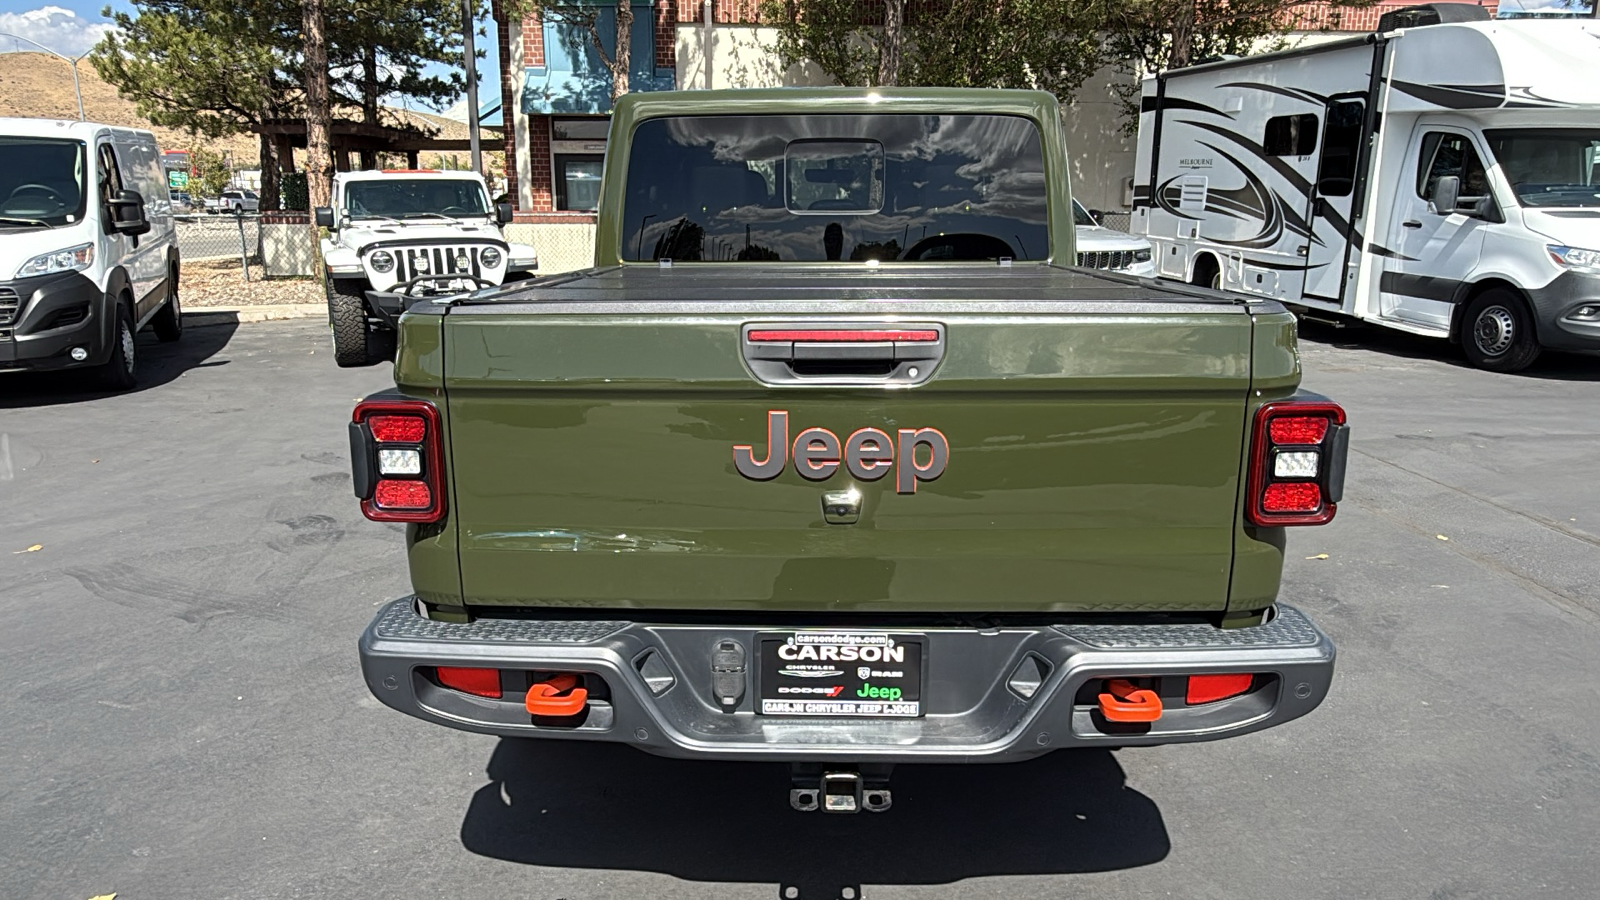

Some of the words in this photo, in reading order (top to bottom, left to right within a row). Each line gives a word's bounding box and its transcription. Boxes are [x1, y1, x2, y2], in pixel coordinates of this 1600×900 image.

[1179, 158, 1213, 166] MELBOURNE
[733, 410, 950, 494] Jeep
[797, 634, 886, 645] carsondodge.com
[778, 643, 904, 663] CARSON
[871, 670, 903, 678] RAM
[778, 686, 835, 694] DODGE
[856, 683, 902, 701] Jeep
[805, 703, 856, 714] CHRYSLER
[857, 703, 882, 714] JEEP
